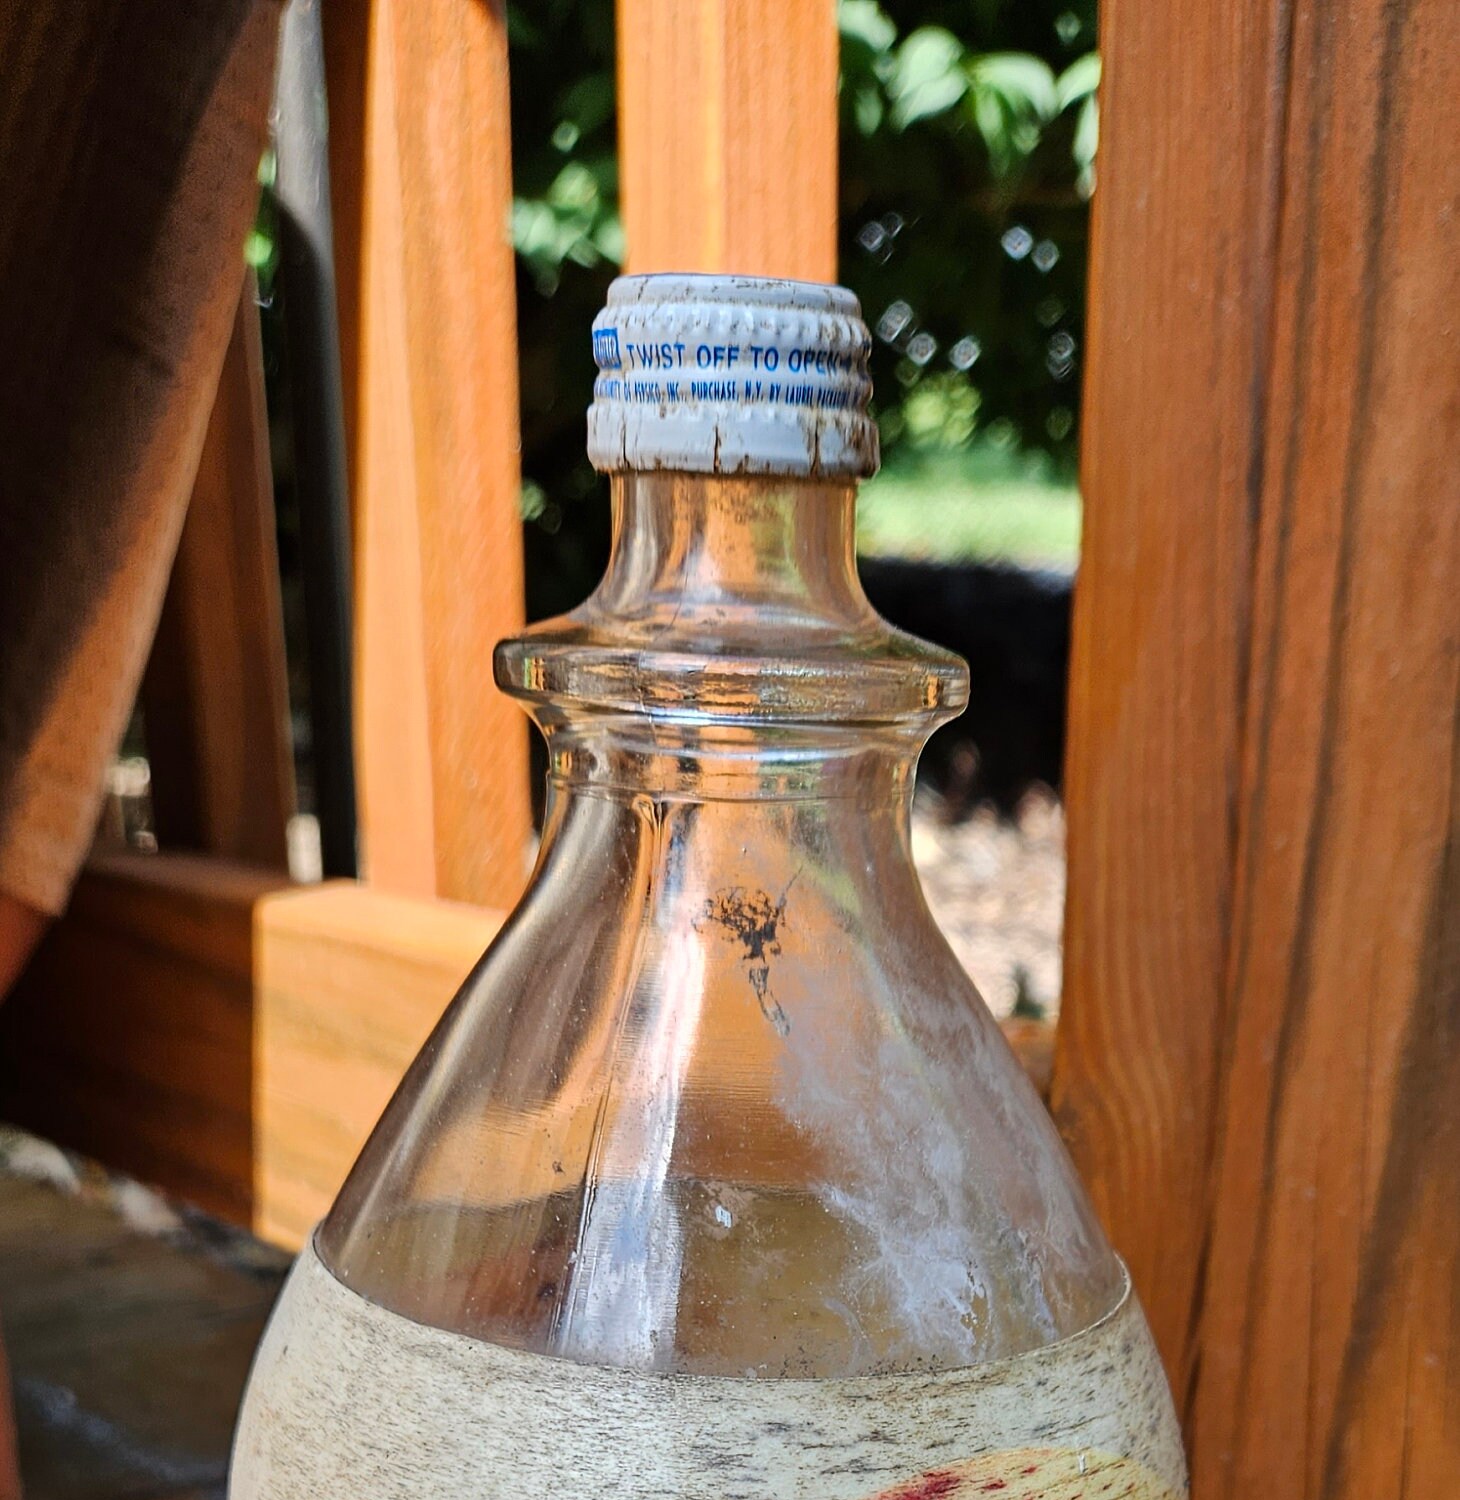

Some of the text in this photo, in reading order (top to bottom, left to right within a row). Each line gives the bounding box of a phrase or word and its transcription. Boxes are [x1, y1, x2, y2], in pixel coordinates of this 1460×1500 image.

[626, 344, 685, 368] TWIST
[697, 344, 739, 370] OFF
[751, 345, 779, 371] TO
[788, 347, 839, 376] OPEN
[769, 382, 781, 403] BY
